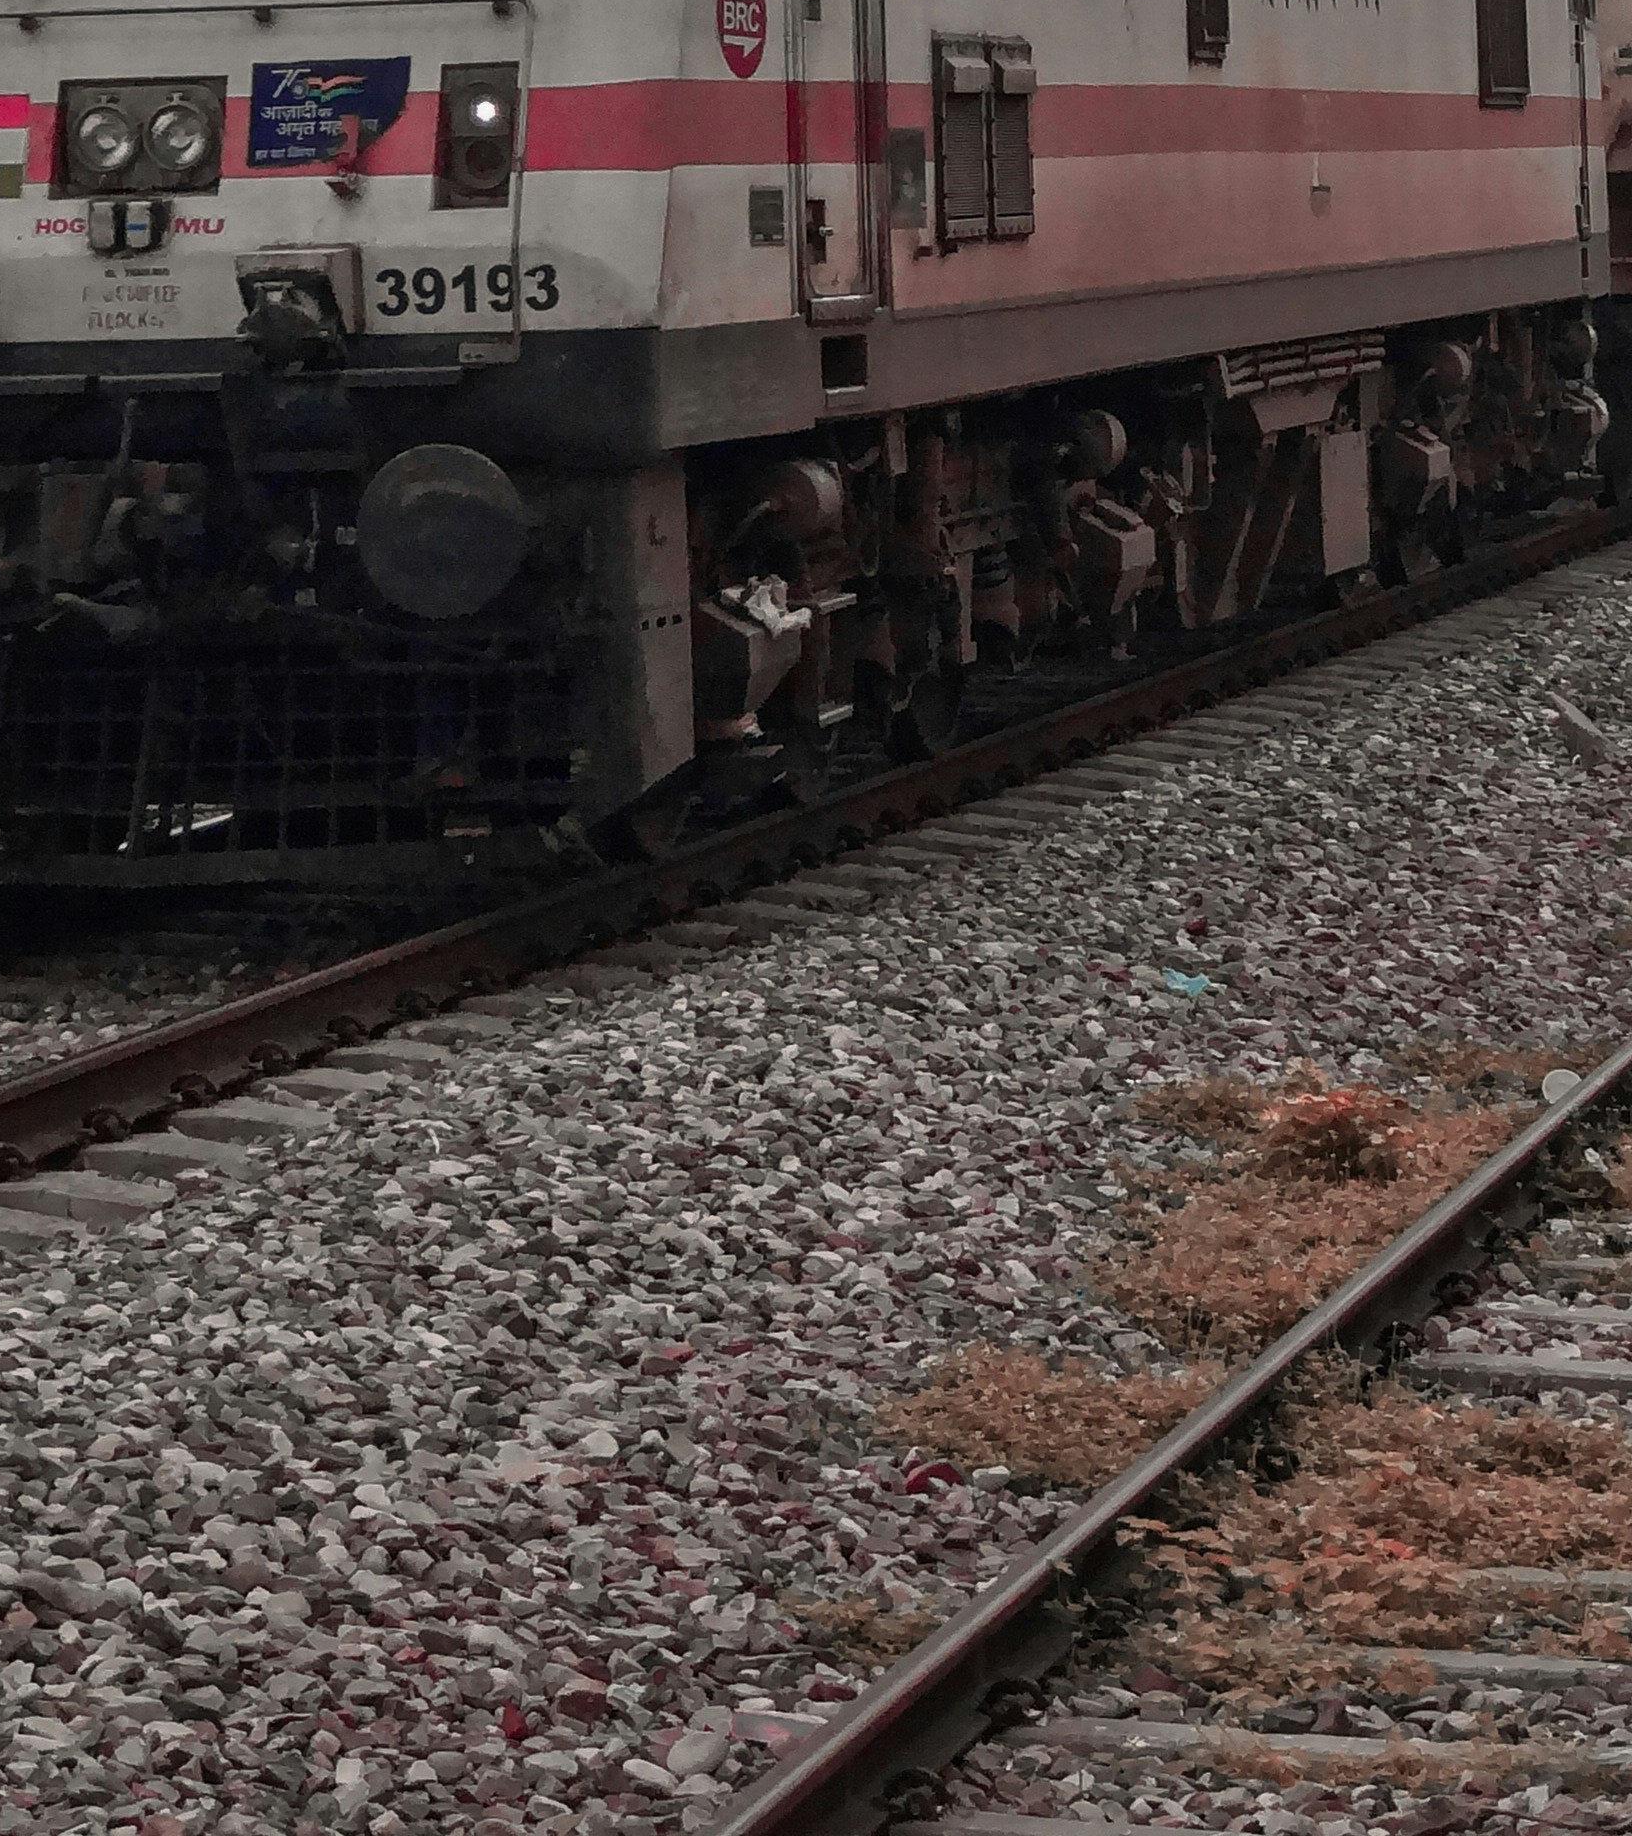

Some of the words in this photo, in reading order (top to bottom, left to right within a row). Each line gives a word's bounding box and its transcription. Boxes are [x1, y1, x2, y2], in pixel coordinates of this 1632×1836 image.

[723, 0, 761, 32] BRC
[35, 217, 87, 235] HOG
[375, 263, 560, 316] 39193
